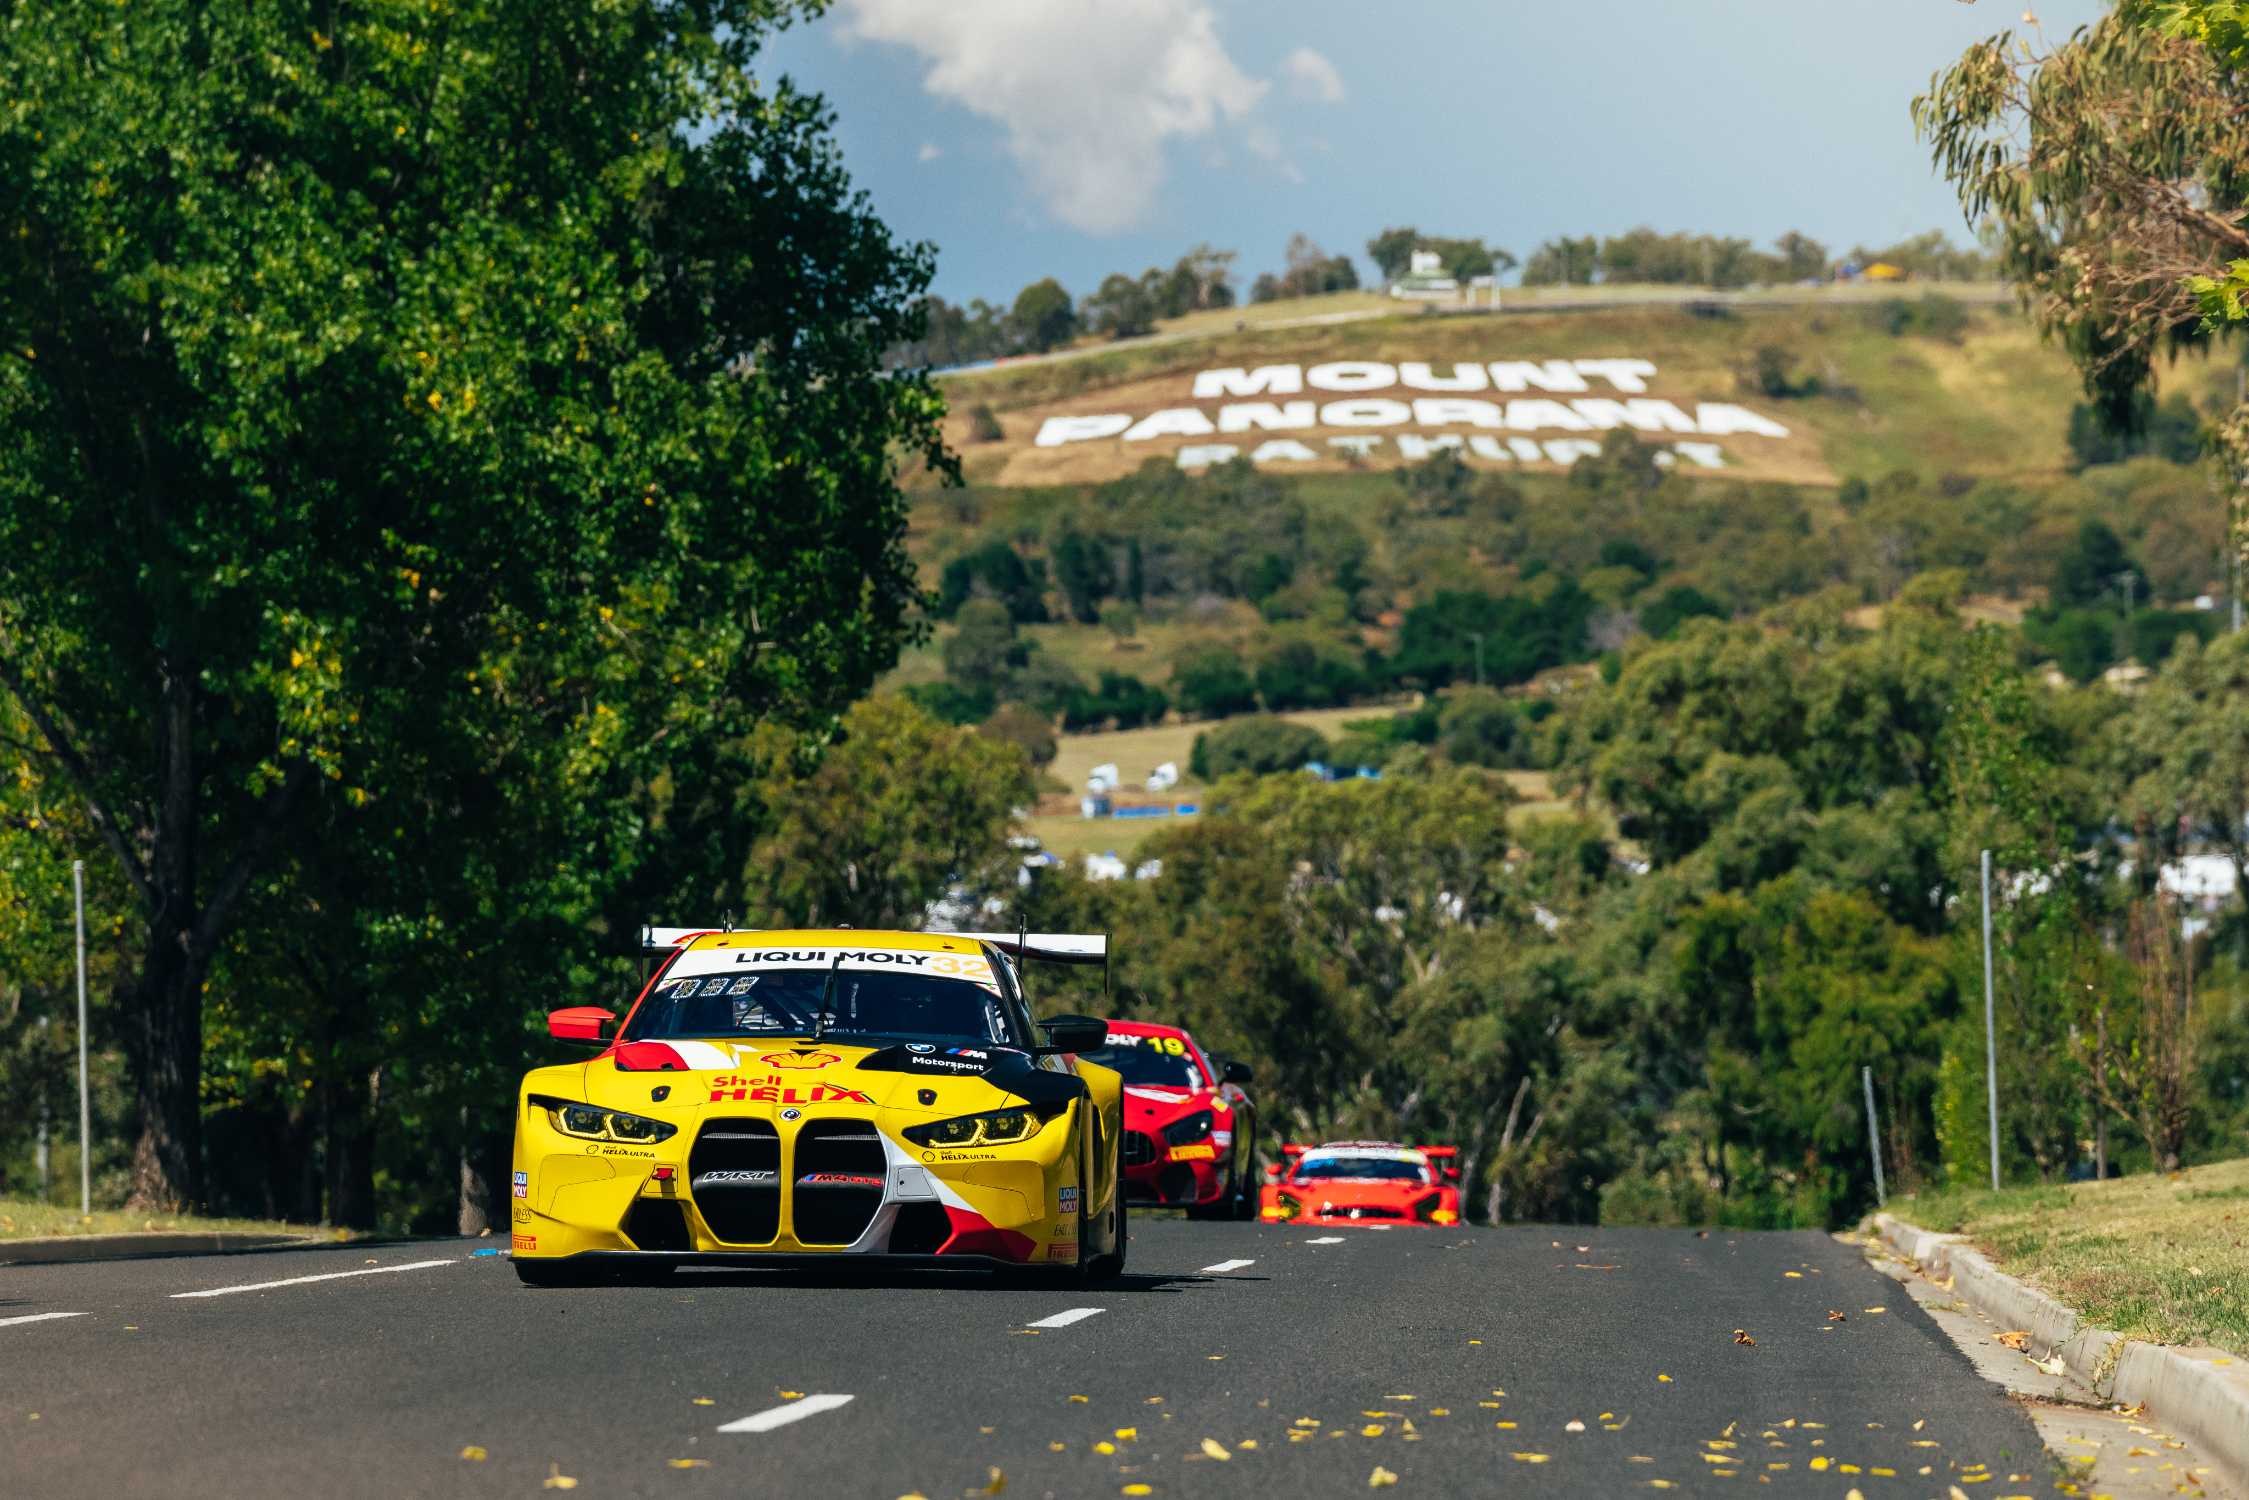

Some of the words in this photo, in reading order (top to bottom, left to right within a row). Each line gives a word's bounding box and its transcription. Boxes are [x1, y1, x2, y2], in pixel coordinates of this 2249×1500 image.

[1193, 358, 1657, 398] MOUNT
[1035, 398, 1789, 446] PANORAMA
[735, 951, 825, 964] LIQUI
[837, 952, 930, 966] MOLY
[930, 955, 992, 979] 32
[1147, 1036, 1185, 1056] 19
[912, 1056, 984, 1071] Motorsport
[713, 1075, 782, 1087] Shell
[709, 1083, 871, 1104] HELIX
[941, 1153, 969, 1161] HELIX
[702, 1170, 775, 1183] WRT
[1059, 1188, 1077, 1200] LIQUI
[1059, 1200, 1077, 1212] MOLY
